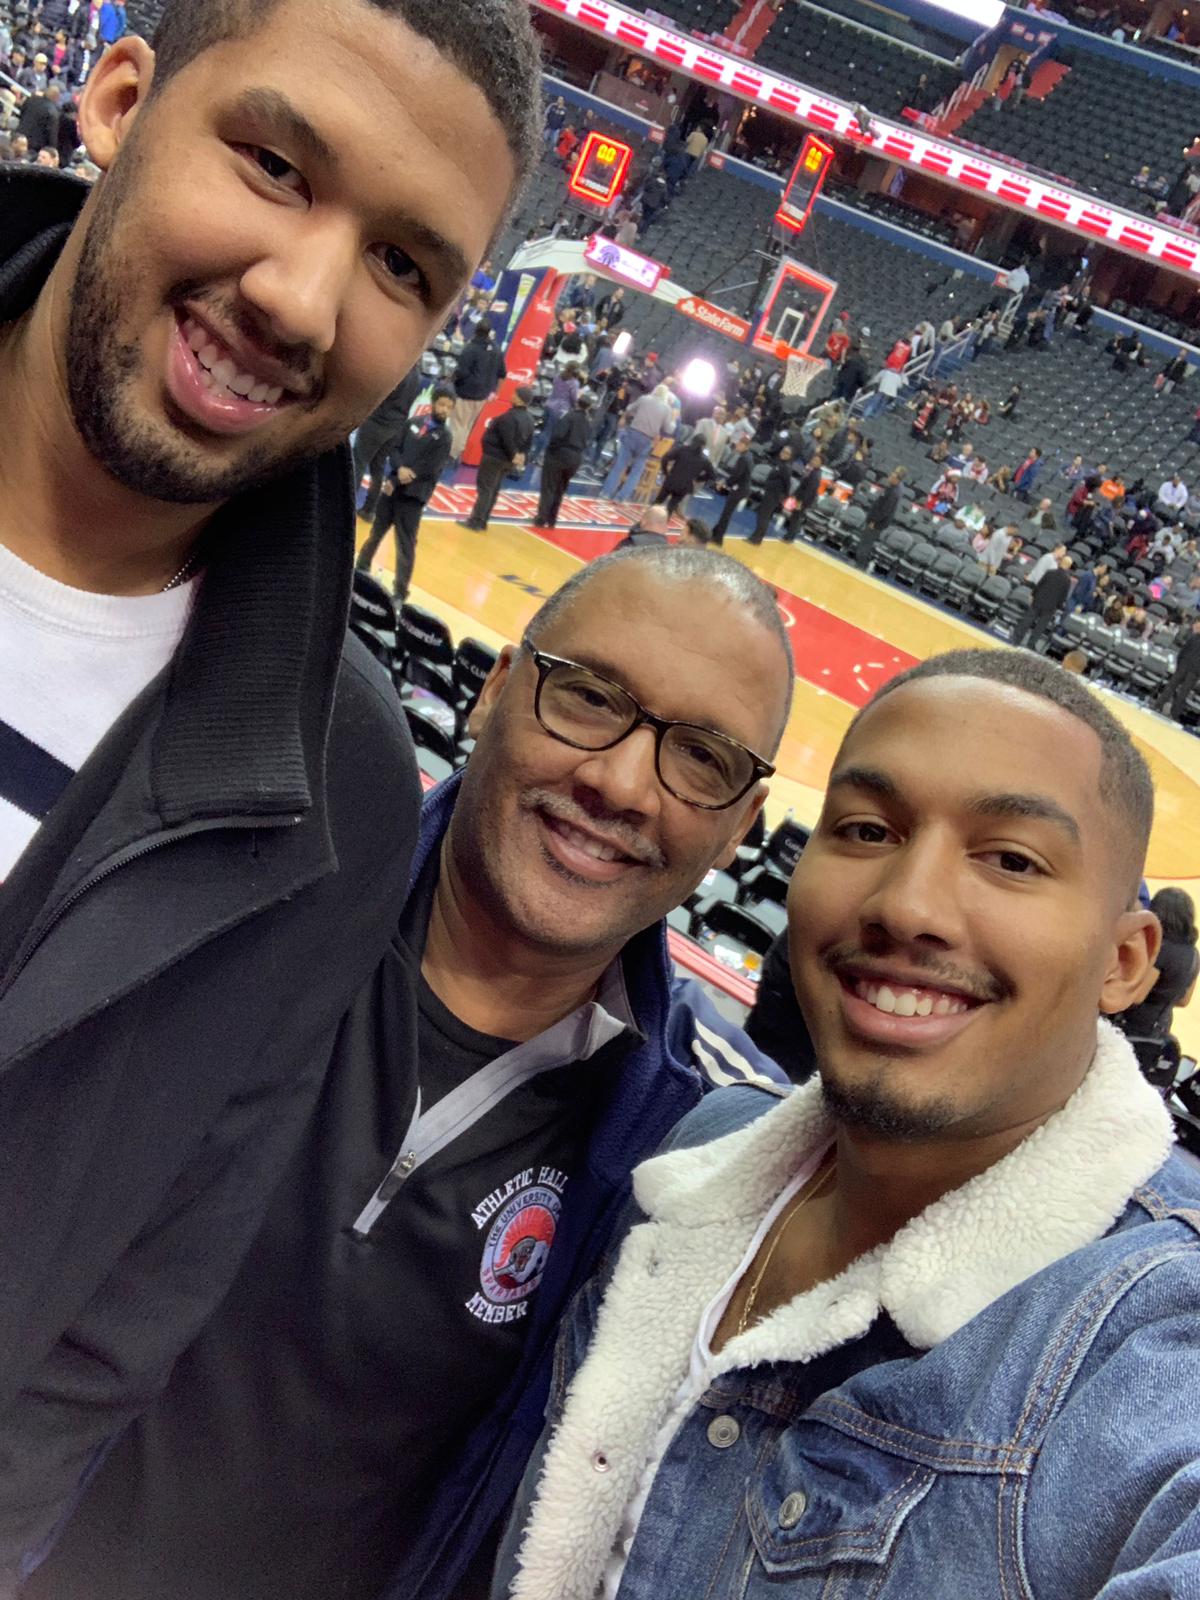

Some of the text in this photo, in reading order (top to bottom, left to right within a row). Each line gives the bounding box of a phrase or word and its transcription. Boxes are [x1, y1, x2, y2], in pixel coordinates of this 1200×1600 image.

[471, 1166, 568, 1230] ATHLETIC HALL
[488, 1226, 502, 1247] THE
[501, 1192, 553, 1223] UNIVERSITY
[465, 1292, 528, 1323] MEMBER
